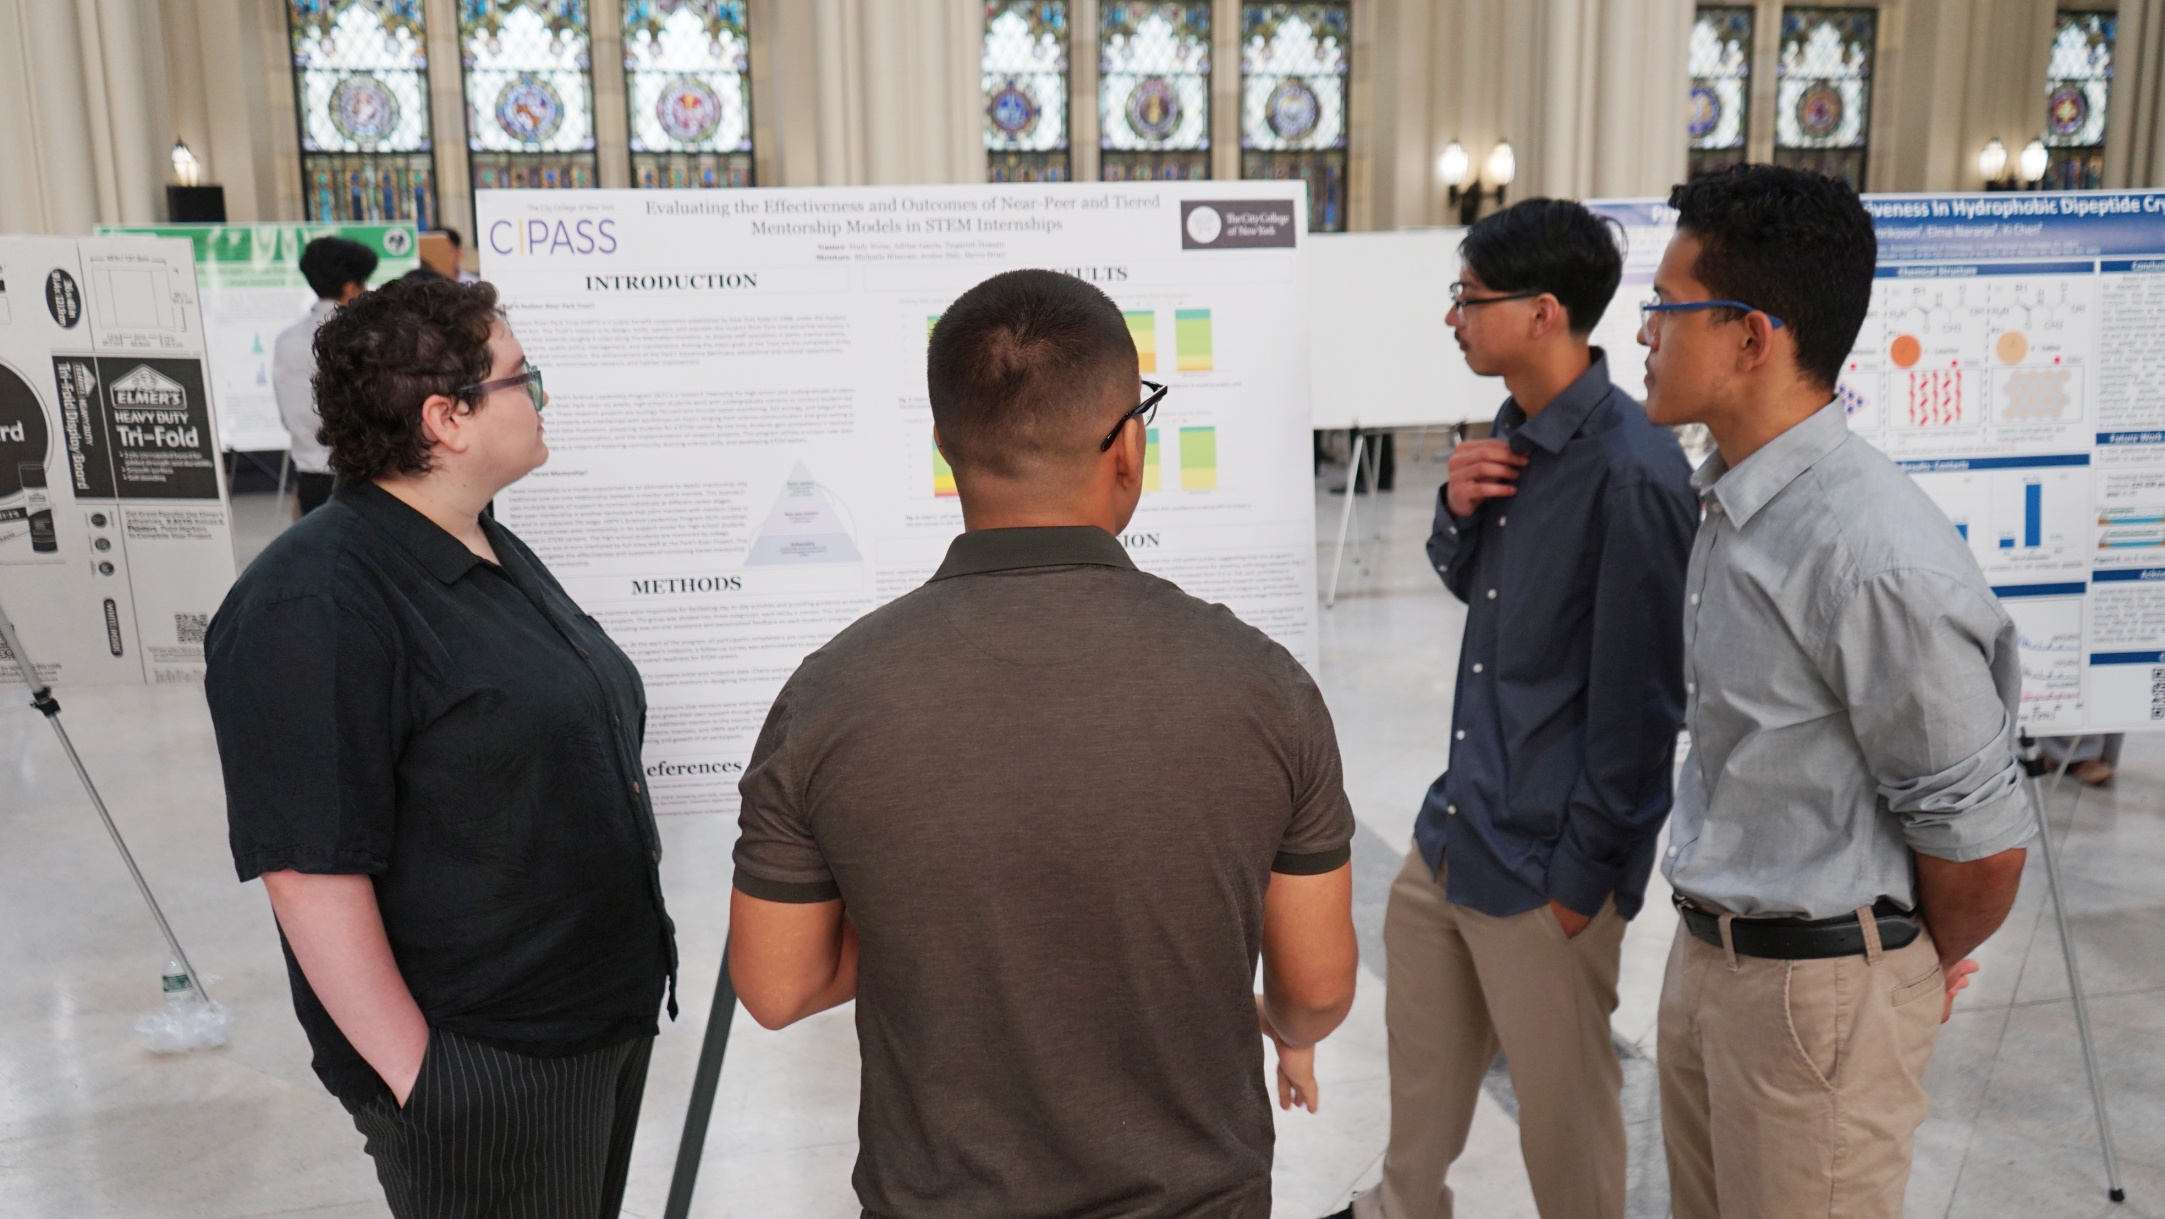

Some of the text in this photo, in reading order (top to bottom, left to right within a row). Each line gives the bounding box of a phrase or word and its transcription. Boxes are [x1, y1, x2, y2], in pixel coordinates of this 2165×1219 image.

[645, 194, 1159, 217] Evaluating the Effectiveness and Outcomes of Near-Peer and Tiered
[1931, 199, 1950, 217] In
[1953, 198, 2058, 219] Hydrophobic
[2060, 195, 2141, 217] Dipeptide
[751, 216, 1062, 238] Mentorship Models in STEM Internships
[1226, 211, 1290, 226] The City College
[490, 219, 618, 255] CIPASS
[1227, 224, 1276, 236] of New York
[586, 273, 758, 291] INTRODUCTION
[117, 391, 181, 405] ELMER'S
[57, 362, 89, 489] Tri-Fold Display Board
[114, 410, 189, 424] HEAVY DUTY
[82, 424, 94, 446] DUTY
[115, 425, 199, 448] Tri-Fold
[631, 577, 742, 595] METHODS
[647, 760, 743, 777] eferences
